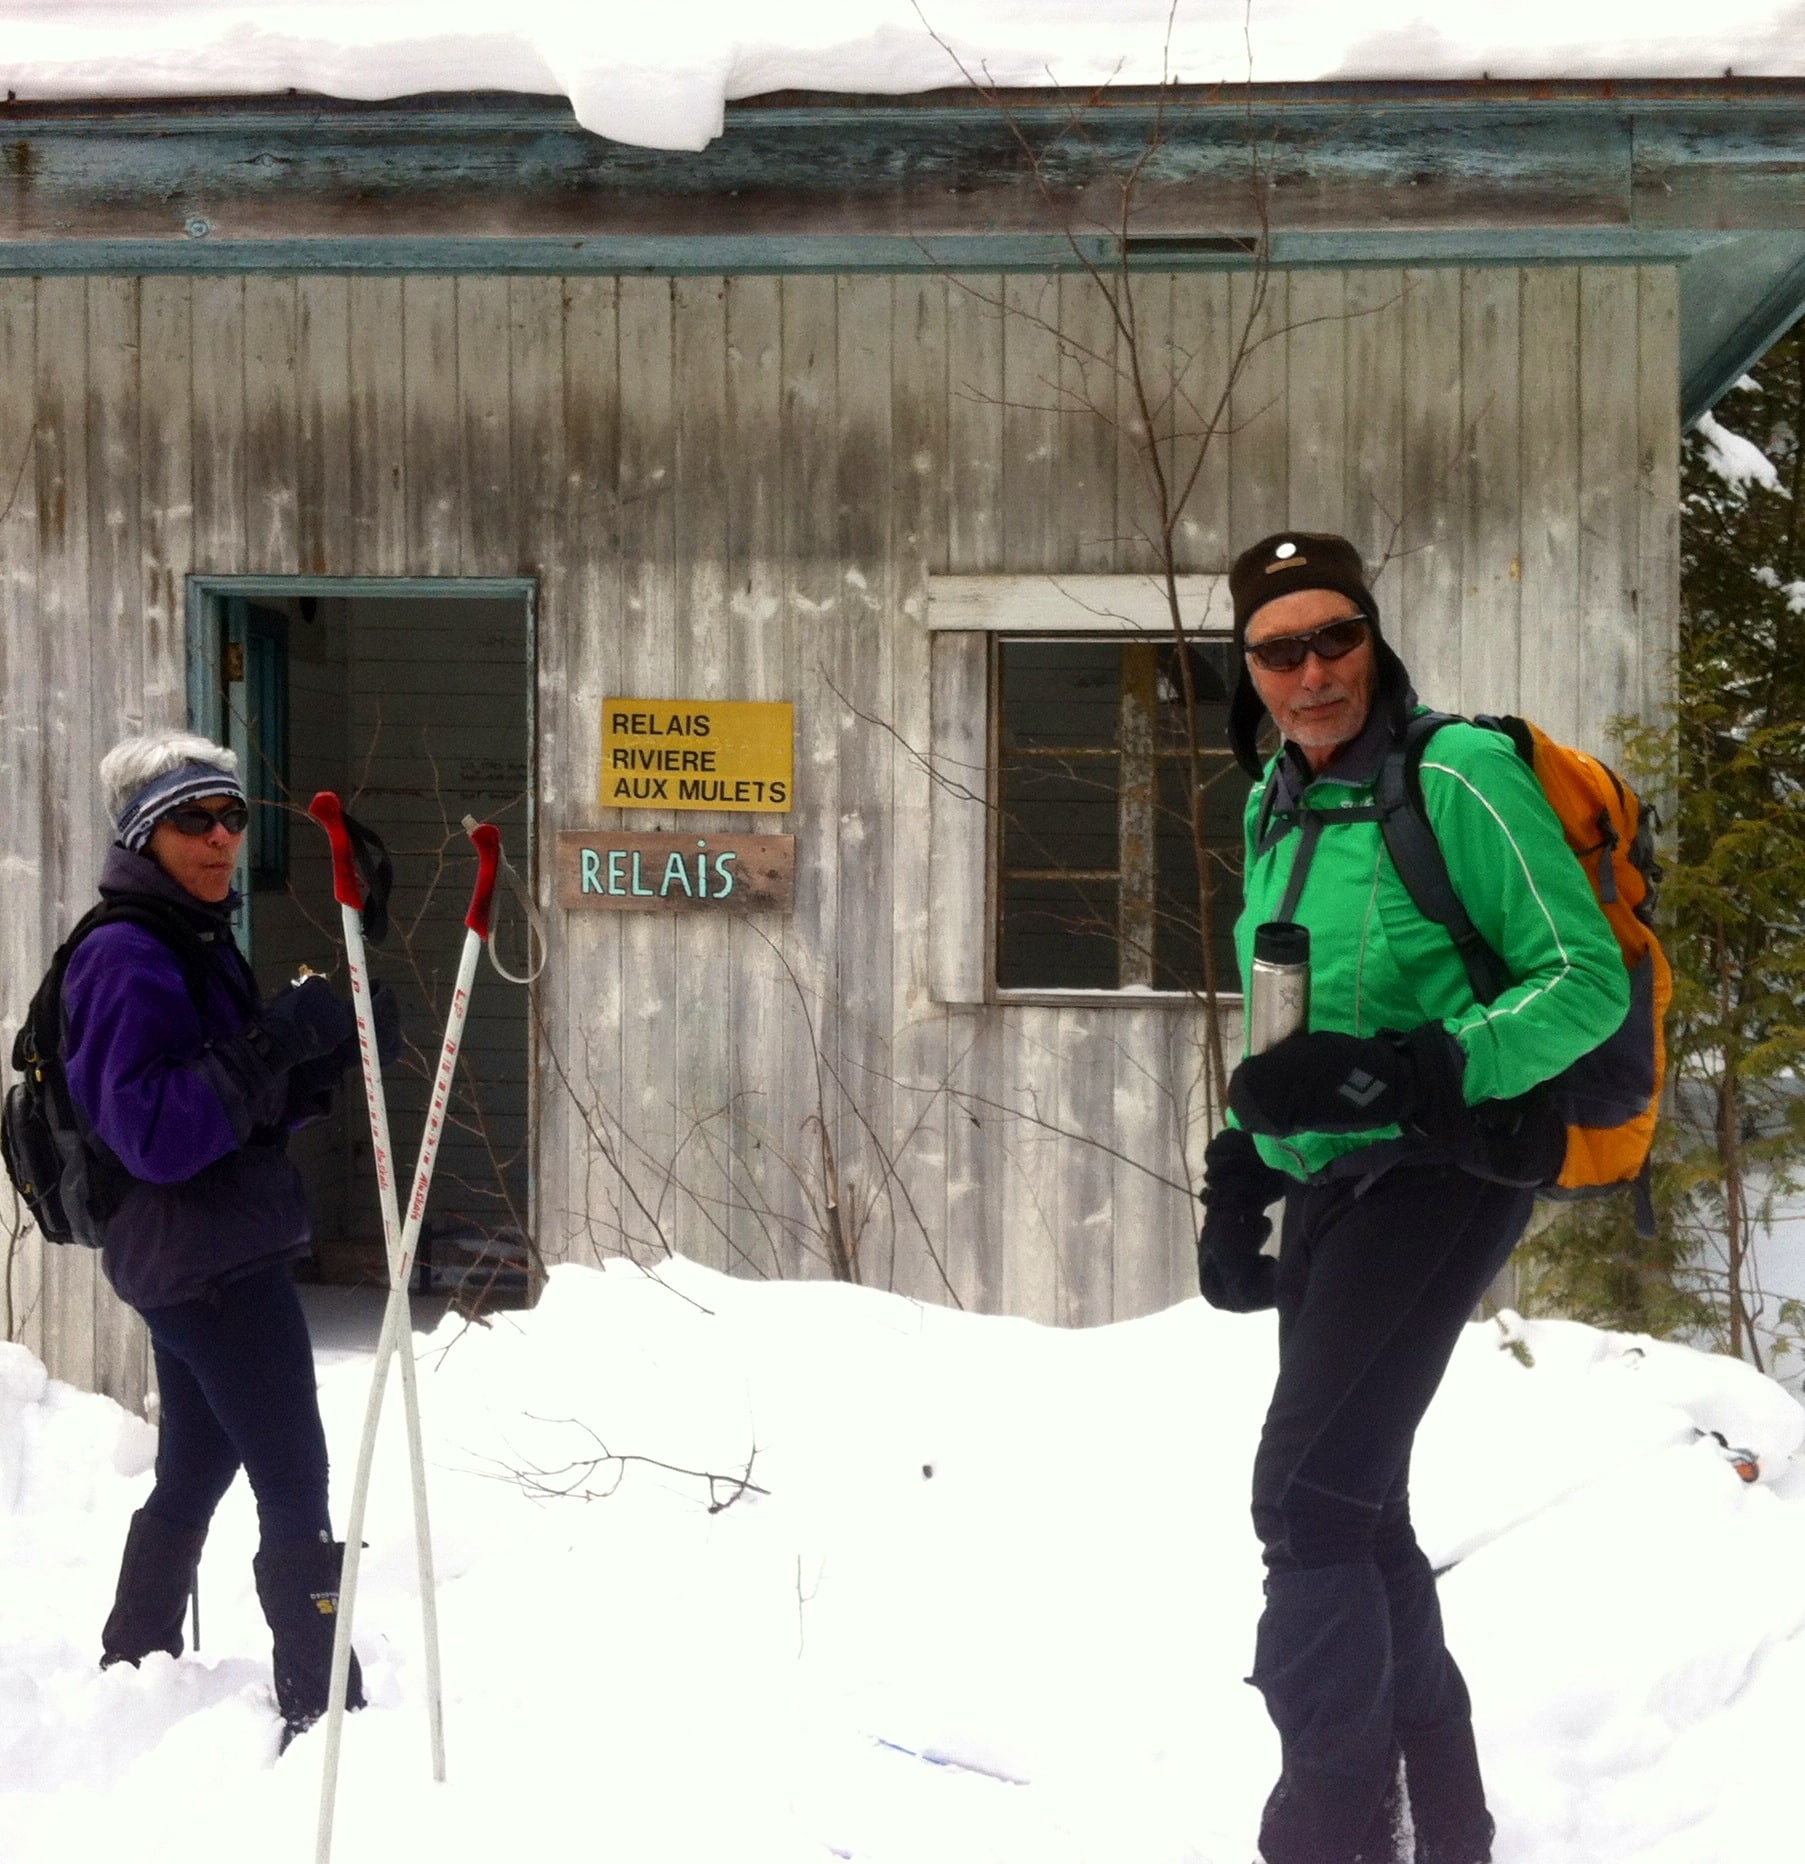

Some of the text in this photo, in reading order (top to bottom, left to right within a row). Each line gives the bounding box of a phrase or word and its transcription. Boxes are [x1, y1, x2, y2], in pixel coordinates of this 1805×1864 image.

[612, 713, 711, 737] RELAIS
[612, 748, 717, 773] RIVIERE
[613, 777, 787, 803] AUX MULETS
